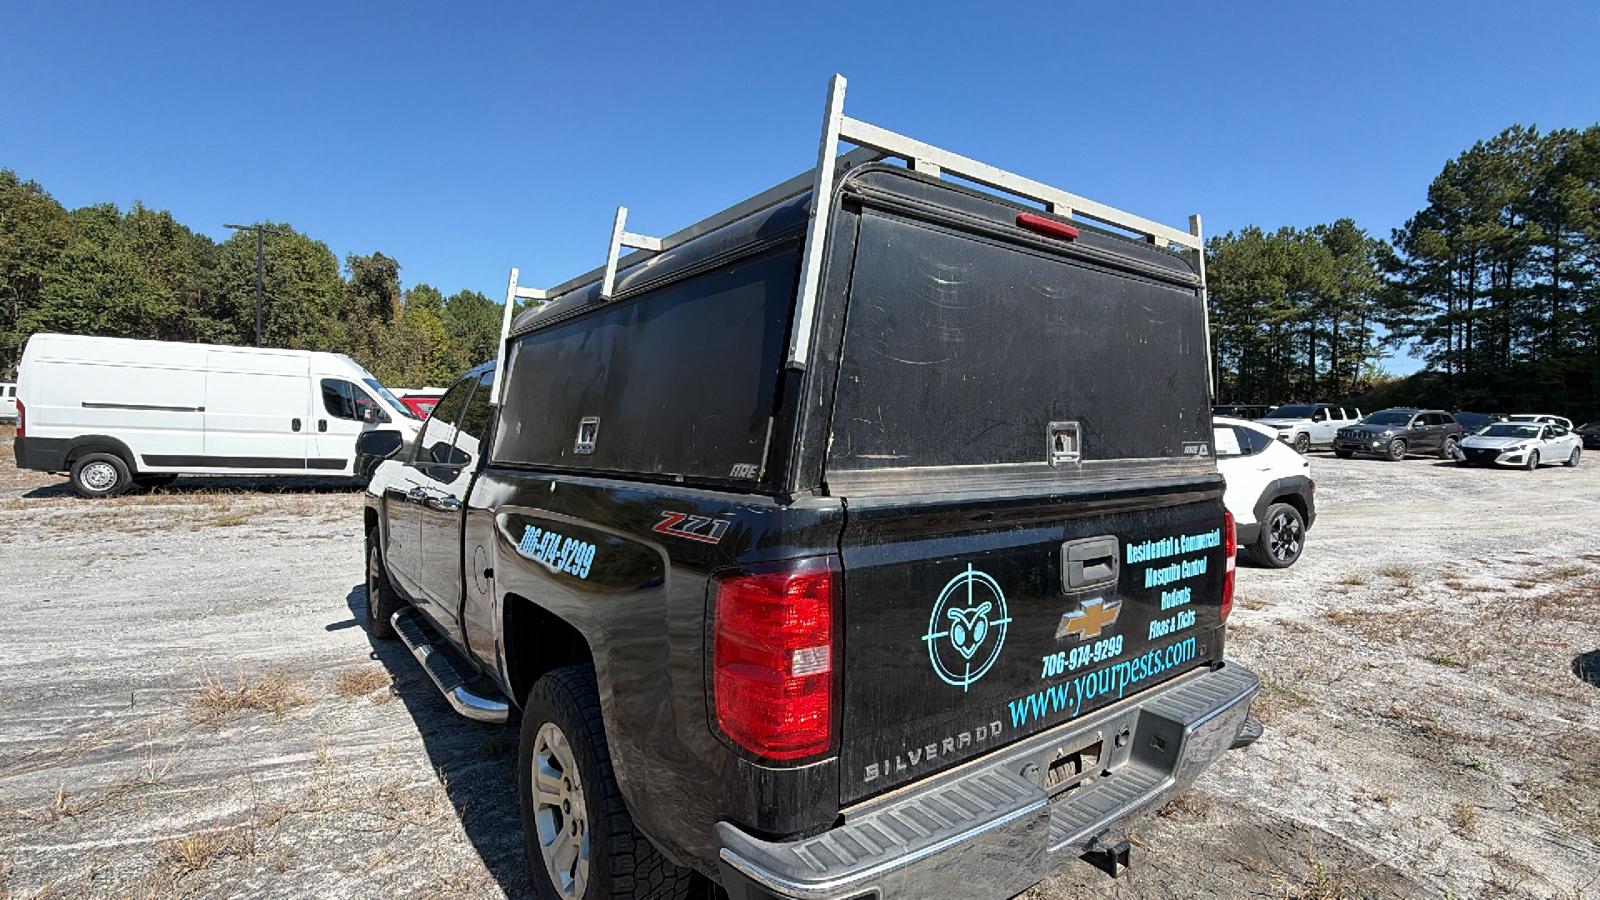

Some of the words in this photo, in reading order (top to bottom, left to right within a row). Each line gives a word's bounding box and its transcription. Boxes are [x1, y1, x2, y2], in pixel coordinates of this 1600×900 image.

[652, 510, 731, 544] Z71
[1126, 536, 1174, 564] Residential
[1174, 538, 1180, 555] &
[1181, 527, 1220, 553] Commercial
[520, 524, 596, 579] 706-974-9299
[1145, 562, 1181, 588] Mosquito
[1181, 555, 1207, 579] Control
[1161, 586, 1191, 610] Rodents
[1148, 619, 1170, 640] Fleas
[1170, 616, 1176, 632] &
[1176, 609, 1196, 630] Ticks
[1041, 634, 1124, 679] 706-974-9299
[1008, 636, 1196, 728] www.yourpests.com
[864, 720, 1003, 783] SILVERADO
